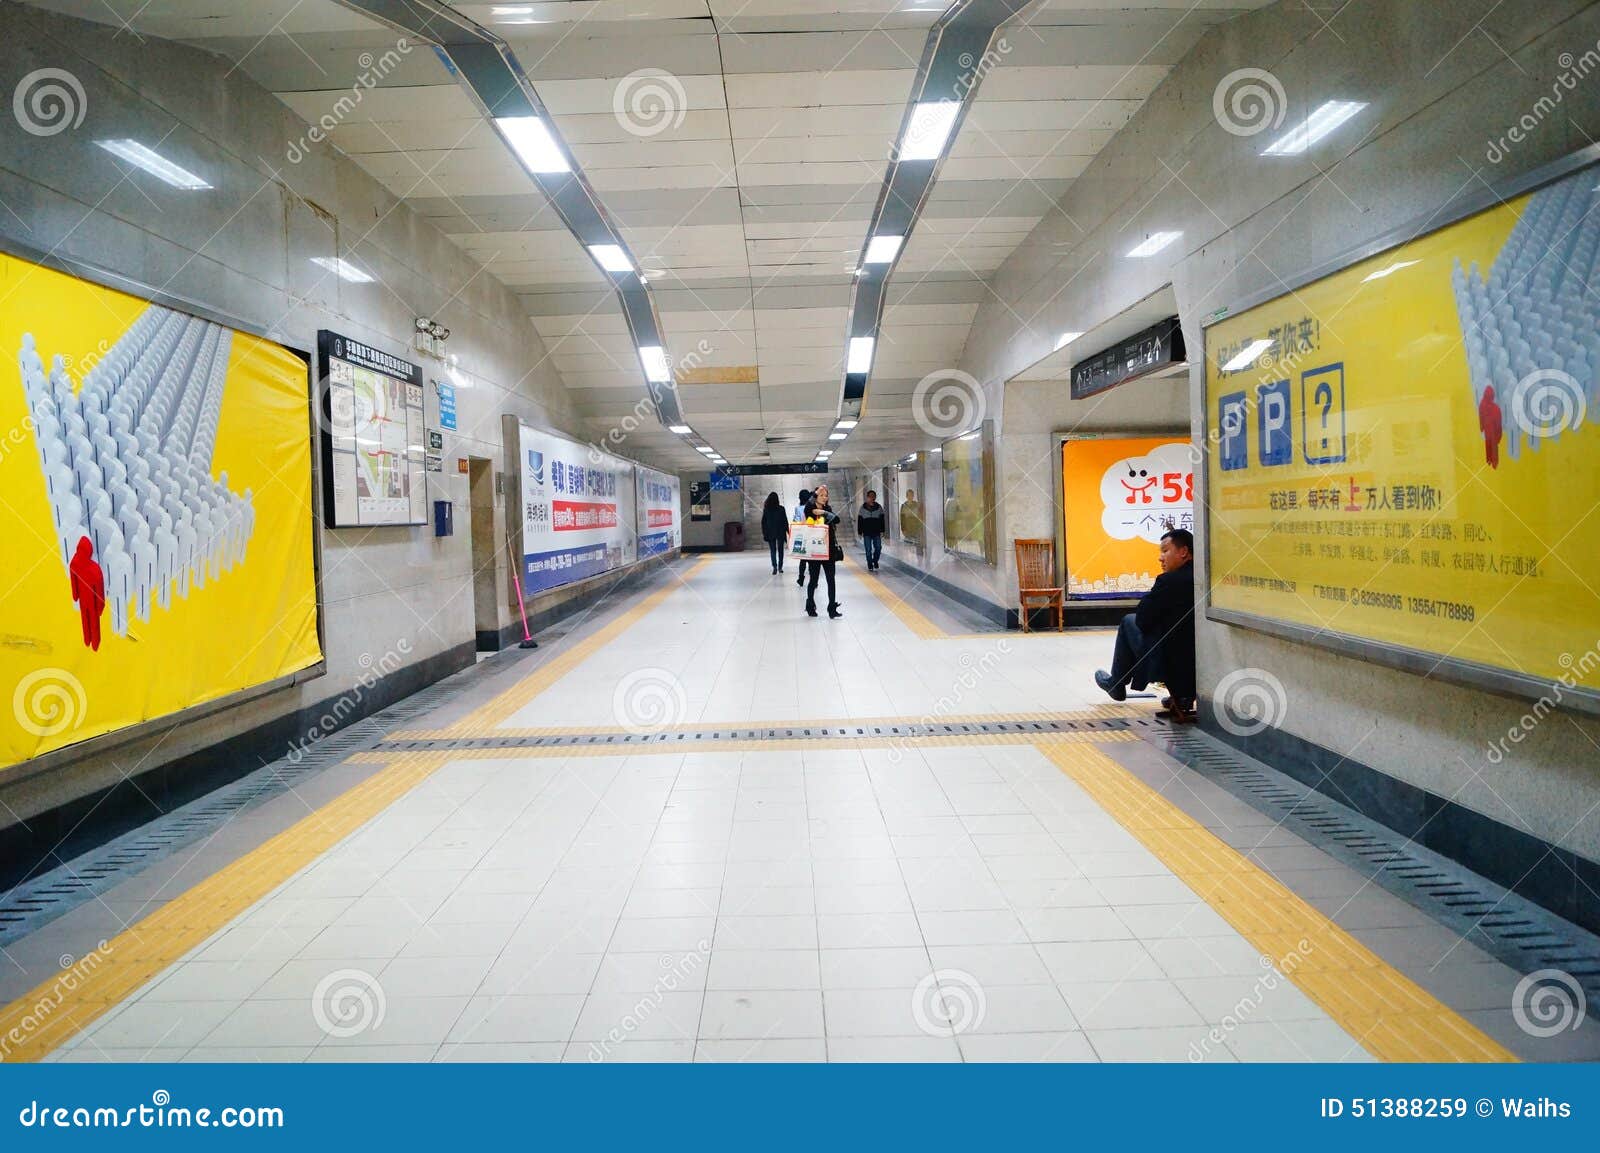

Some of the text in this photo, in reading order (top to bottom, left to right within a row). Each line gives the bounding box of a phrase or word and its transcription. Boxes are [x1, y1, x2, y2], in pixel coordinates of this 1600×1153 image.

[1264, 391, 1286, 454] P
[690, 482, 699, 492] 5
[1361, 590, 1402, 610] 82963905
[1407, 597, 1475, 622] 13554778899
